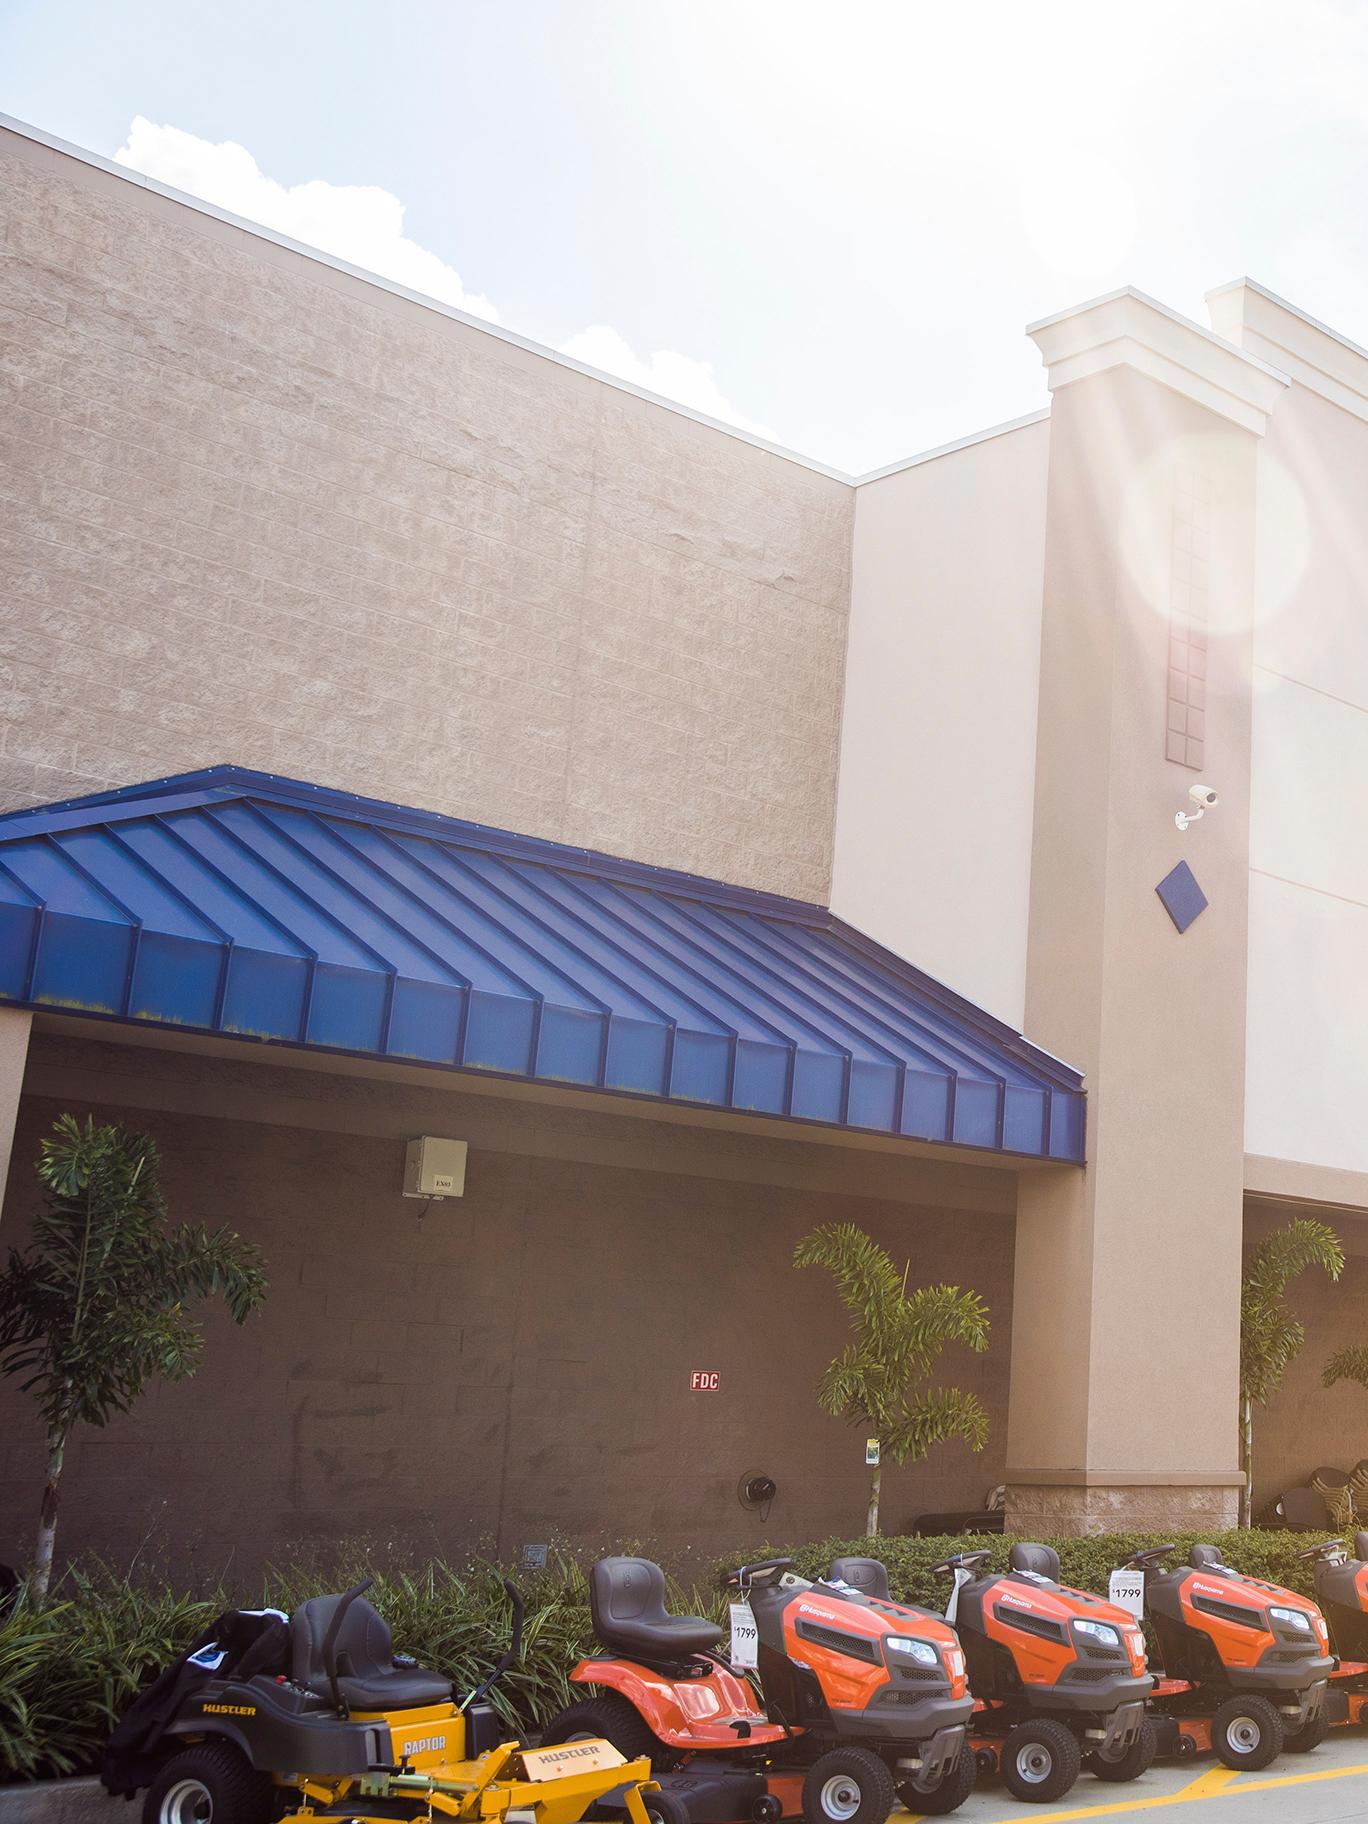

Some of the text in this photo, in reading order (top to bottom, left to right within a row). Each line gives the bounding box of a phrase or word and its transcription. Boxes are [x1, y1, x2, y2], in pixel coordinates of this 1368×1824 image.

[692, 1373, 718, 1389] FDC
[1112, 1588, 1141, 1598] $1799
[734, 1627, 757, 1639] $1799
[203, 1703, 257, 1716] HUSTLER
[404, 1736, 446, 1756] RAPTOR
[538, 1745, 601, 1765] HUSTLER
